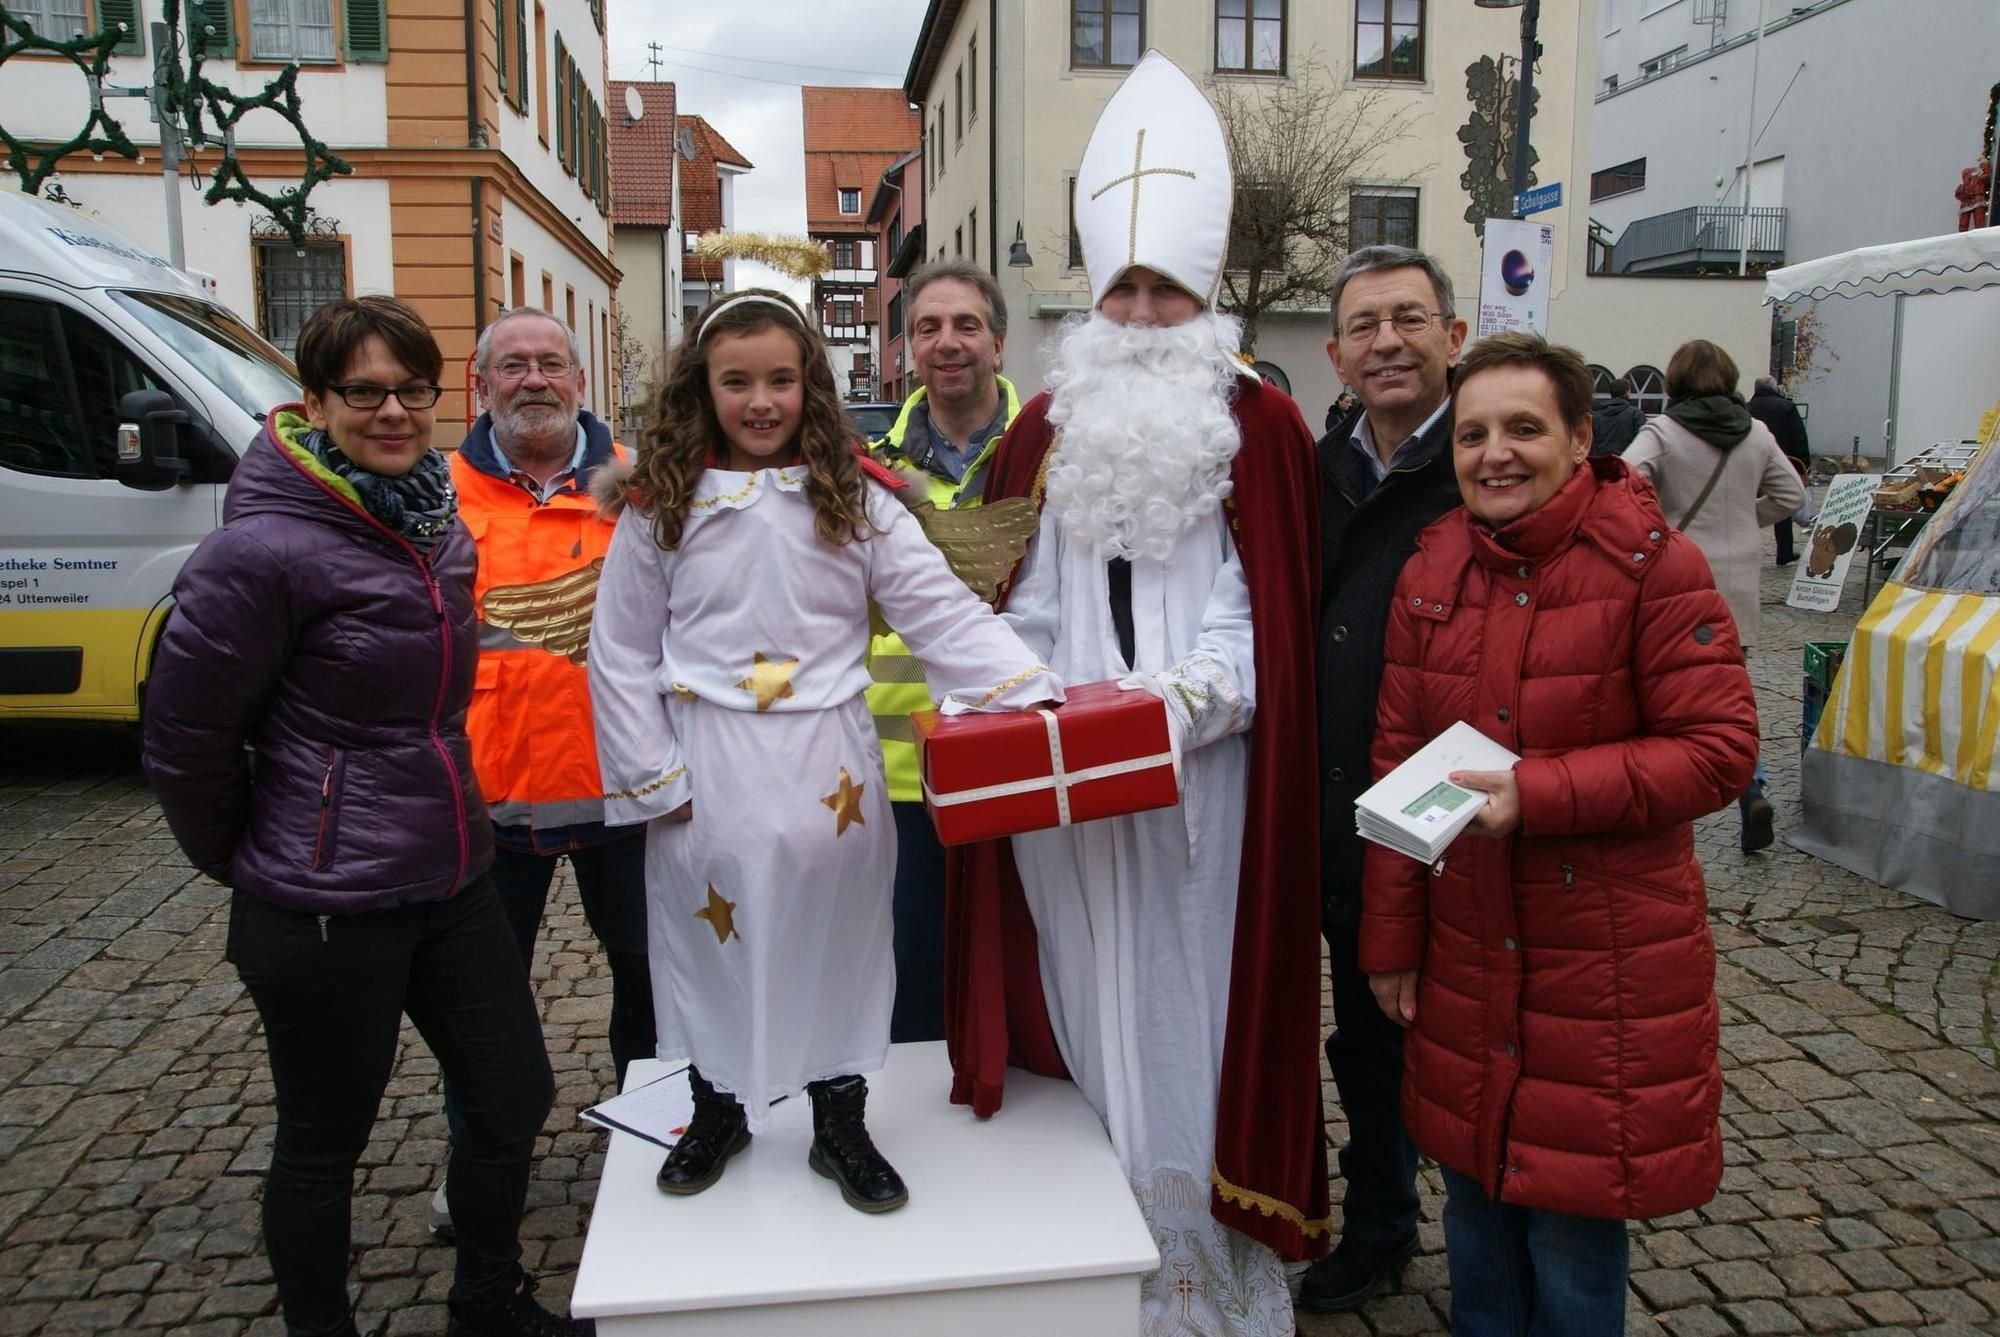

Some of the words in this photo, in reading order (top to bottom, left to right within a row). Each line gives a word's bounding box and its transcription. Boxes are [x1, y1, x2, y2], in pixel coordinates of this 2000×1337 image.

[1520, 190, 1559, 210] Schulgasse
[53, 557, 118, 570] Semtner
[33, 578, 39, 588] 1
[17, 593, 89, 604] Uttenweiler
